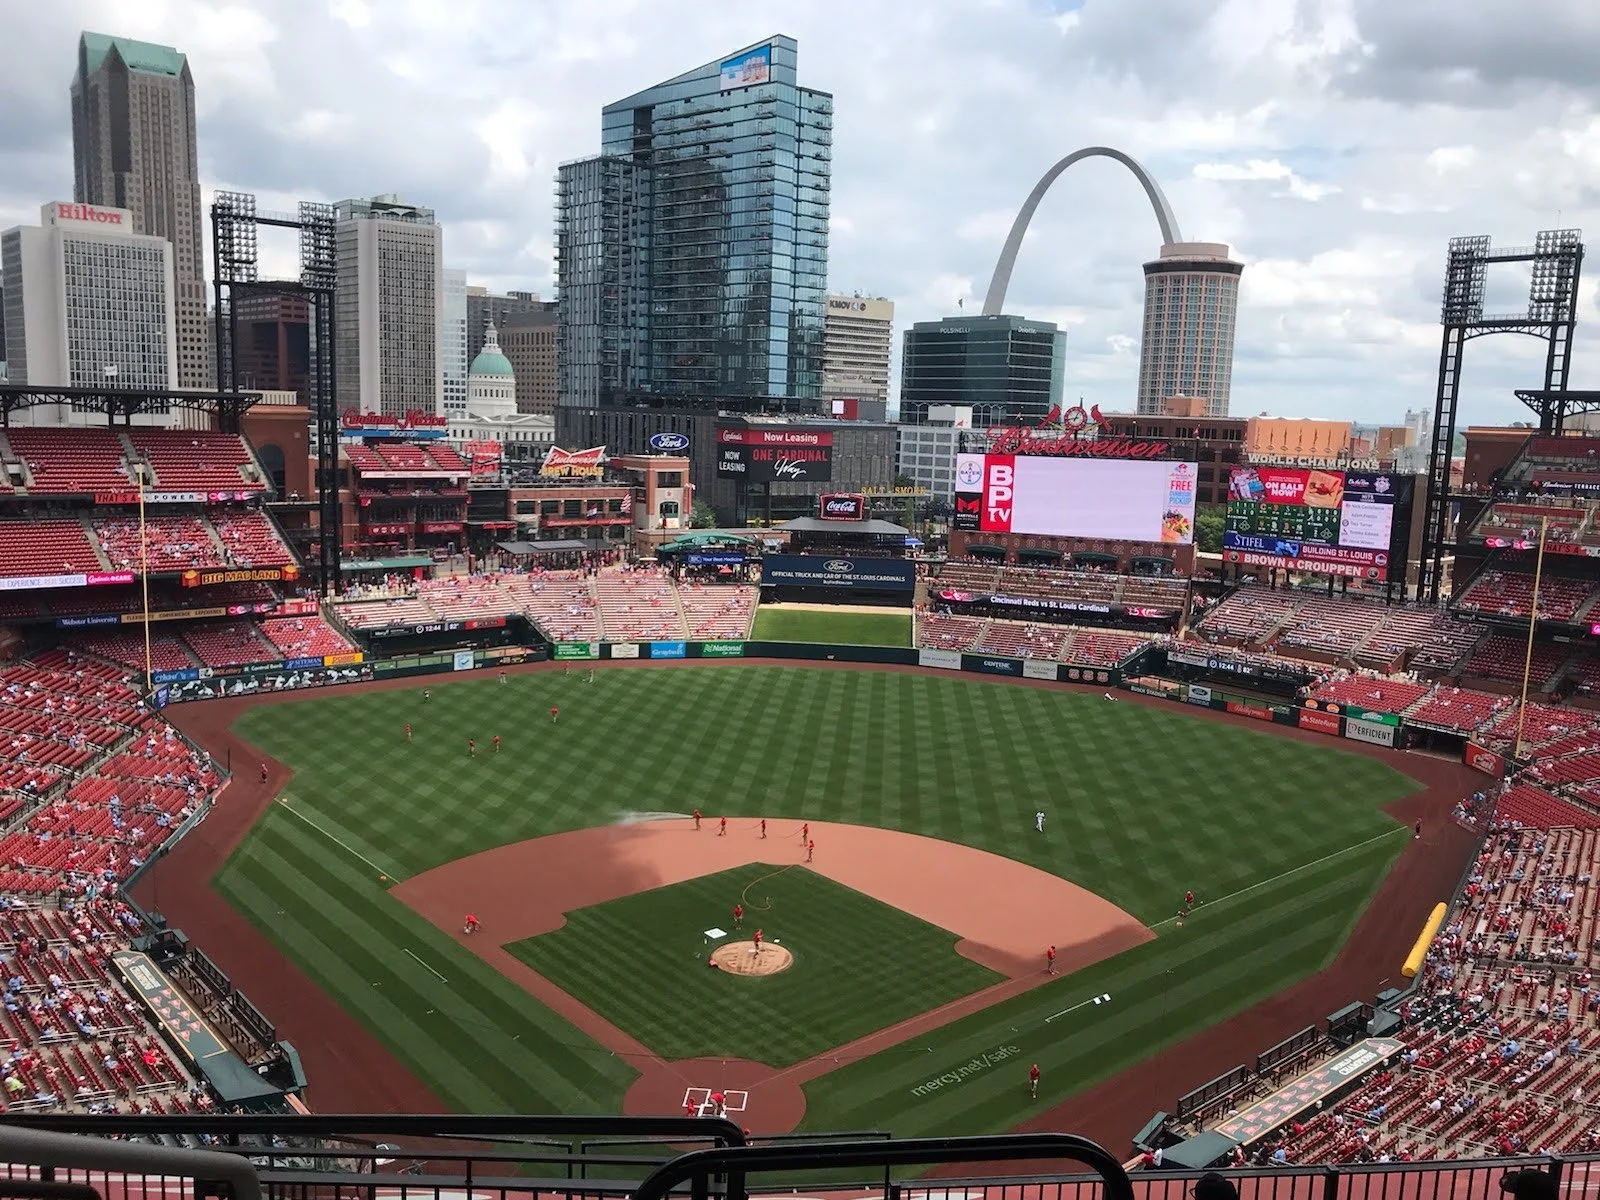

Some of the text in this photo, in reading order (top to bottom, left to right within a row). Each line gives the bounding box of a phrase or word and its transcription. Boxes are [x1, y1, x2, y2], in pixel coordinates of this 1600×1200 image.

[57, 203, 122, 224] Hilton
[829, 299, 851, 309] KMOV
[342, 407, 447, 430] Cardinals Nation
[658, 435, 682, 447] Ford
[723, 430, 743, 442] Cardinals
[764, 432, 818, 444] Now Leasing
[985, 425, 1168, 457] Budweiser
[724, 451, 740, 460] NOW
[752, 449, 828, 461] ONE CARDINAL
[718, 462, 746, 472] LEASING
[774, 456, 806, 479] Way
[1248, 453, 1380, 470] WORLD CHAMPIONS
[541, 466, 604, 476] BREW HOUSE
[861, 486, 926, 494] SALT SMOKE
[1170, 480, 1192, 491] FREE
[1280, 482, 1304, 492] SALE
[98, 493, 128, 503] THAT'S
[1271, 489, 1296, 498] NOW!
[826, 500, 857, 512] Coca-Cola
[988, 508, 1010, 522] TV
[1235, 534, 1264, 548] STIFEL
[1302, 545, 1337, 557] BUILDING
[1338, 550, 1350, 558] ST.
[1350, 551, 1373, 560] LOUIS
[828, 561, 849, 571] Ford
[1244, 553, 1363, 576] BROWN & CROUPPEN
[6, 580, 41, 588] EXPERIENCE
[60, 576, 85, 586] SUCCESS
[202, 570, 281, 584] BIG MAC LAND
[990, 596, 1022, 606] Cincinnati
[1023, 598, 1040, 607] Reds
[1078, 604, 1110, 613] Cardinals
[62, 616, 118, 626] Webster University
[294, 657, 322, 666] SITEMAN
[1218, 662, 1235, 671] 12:44
[1130, 686, 1167, 698] BUSCH STADIUM
[910, 1044, 1021, 1096] mercy.net/safe
